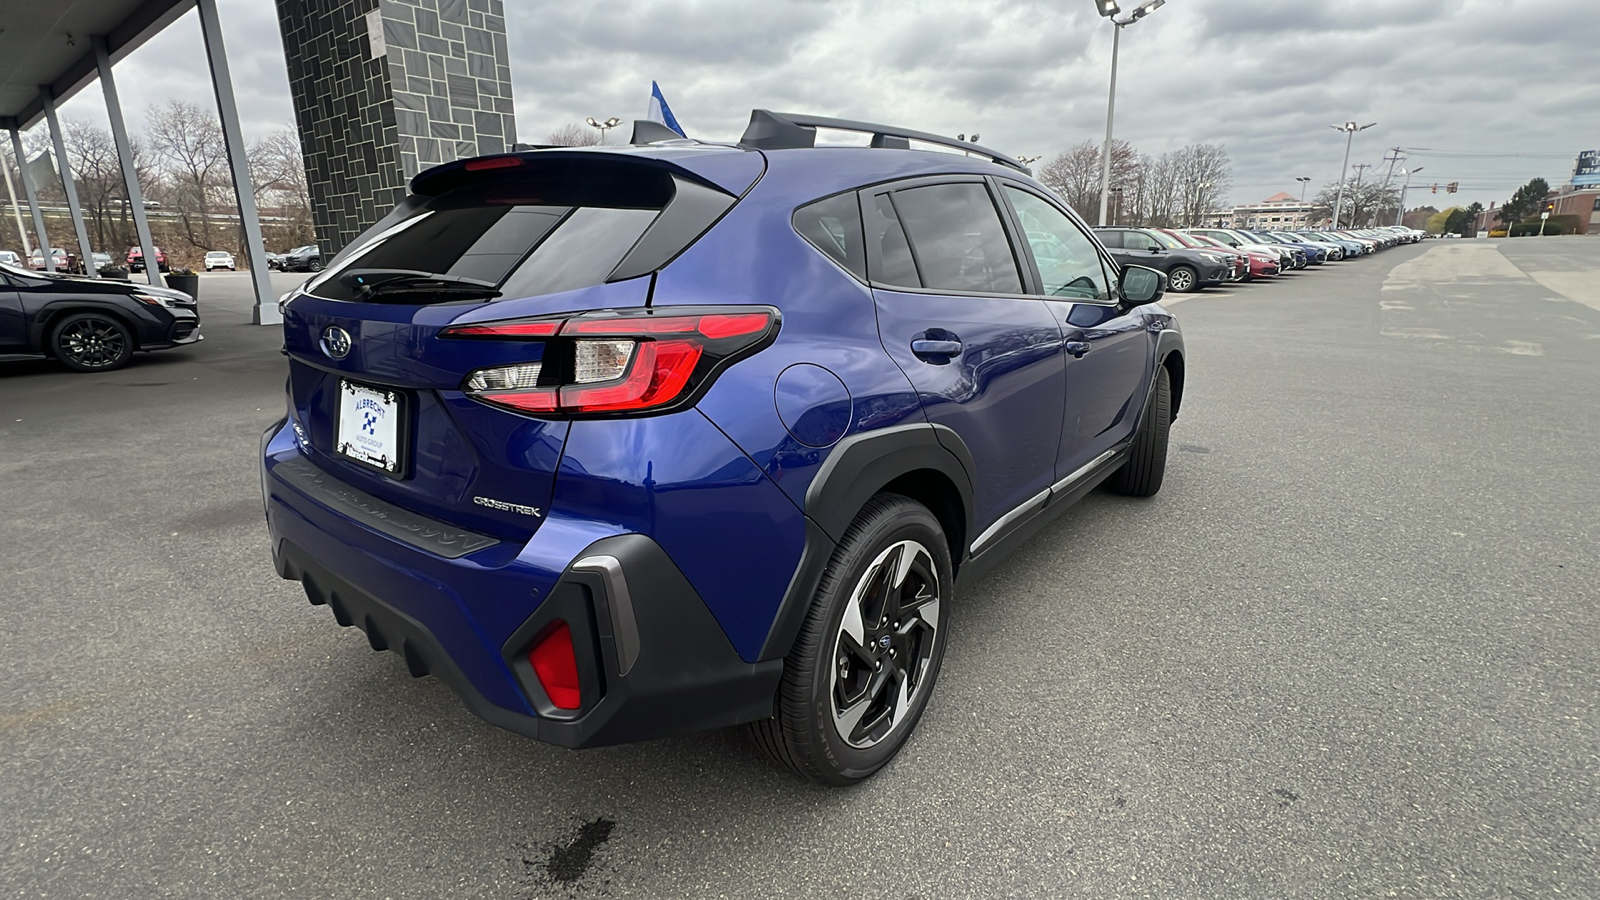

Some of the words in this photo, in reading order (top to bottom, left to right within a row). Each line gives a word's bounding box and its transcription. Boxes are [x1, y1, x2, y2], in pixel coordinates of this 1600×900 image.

[355, 398, 385, 419] ALBRECHT
[356, 435, 368, 444] AUTO
[368, 438, 383, 448] GROUP
[473, 496, 541, 517] CROSSTREK
